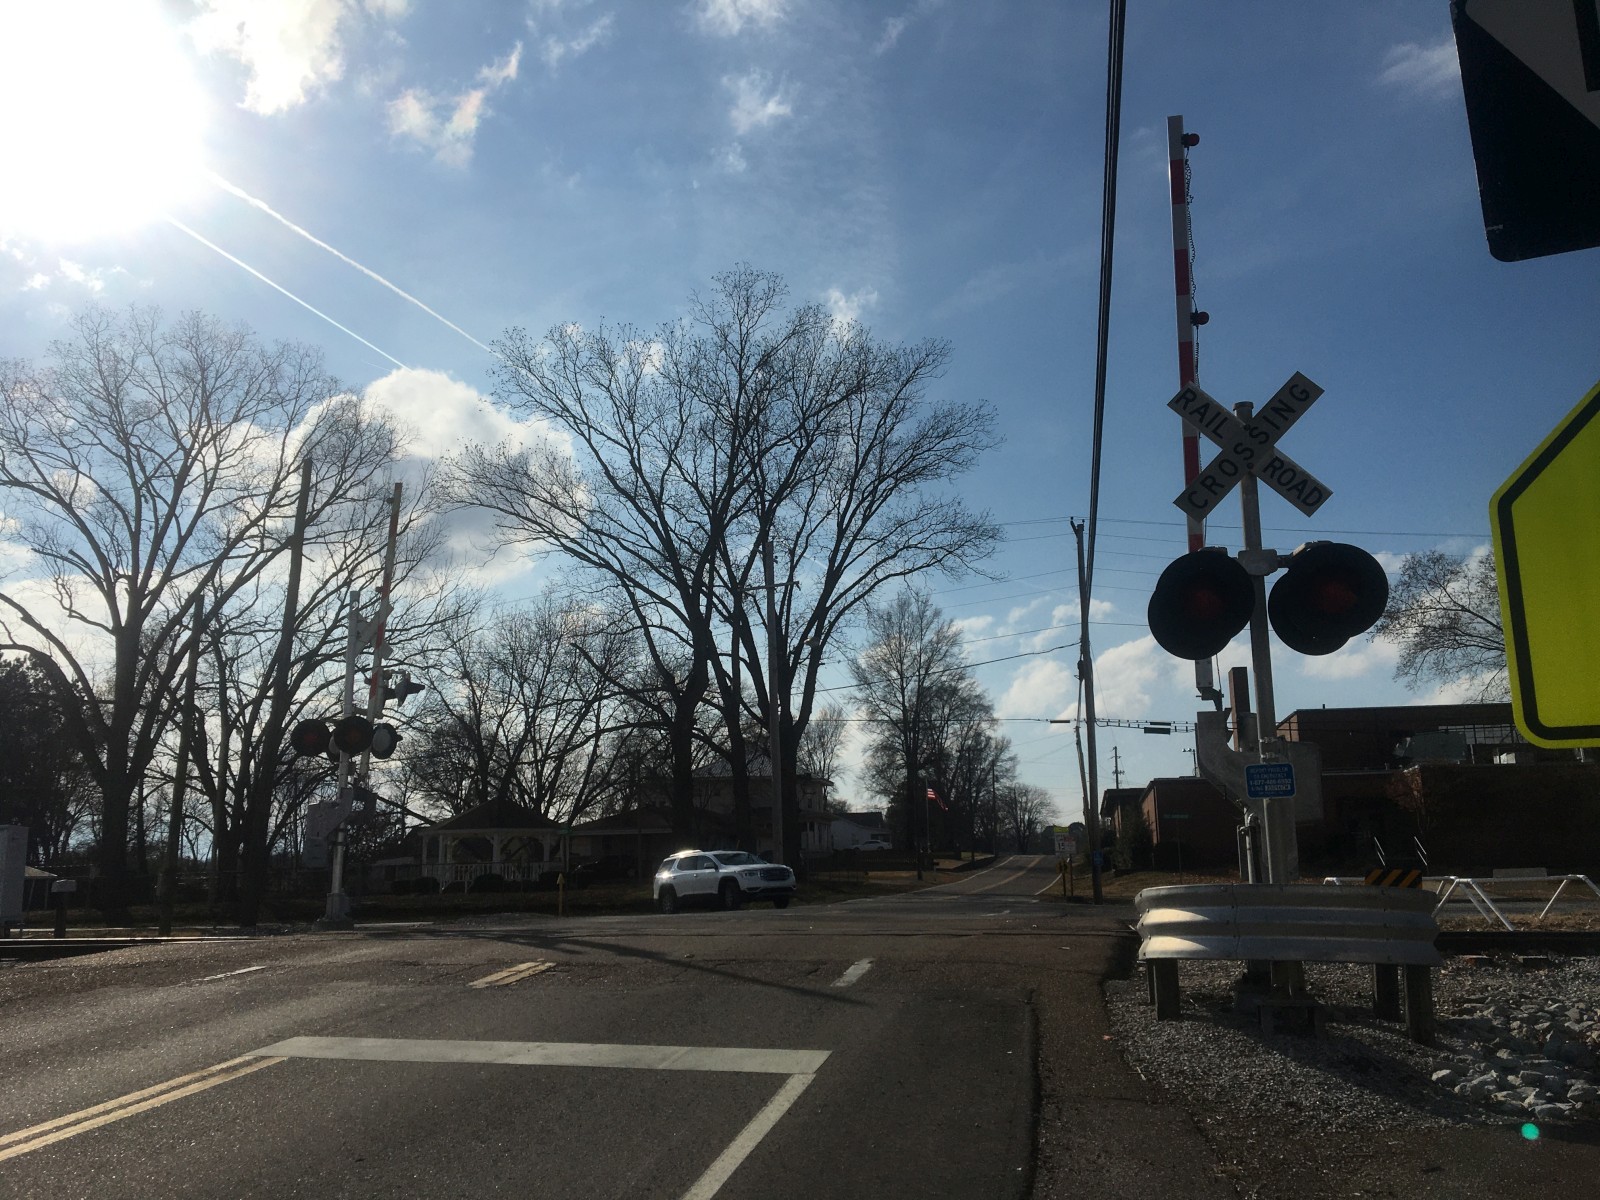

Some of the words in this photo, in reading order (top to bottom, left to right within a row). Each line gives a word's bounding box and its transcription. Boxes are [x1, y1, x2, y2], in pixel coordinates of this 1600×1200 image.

[1175, 388, 1228, 439] RAIL
[1262, 456, 1323, 507] ROAD
[1187, 384, 1310, 509] CROSSING
